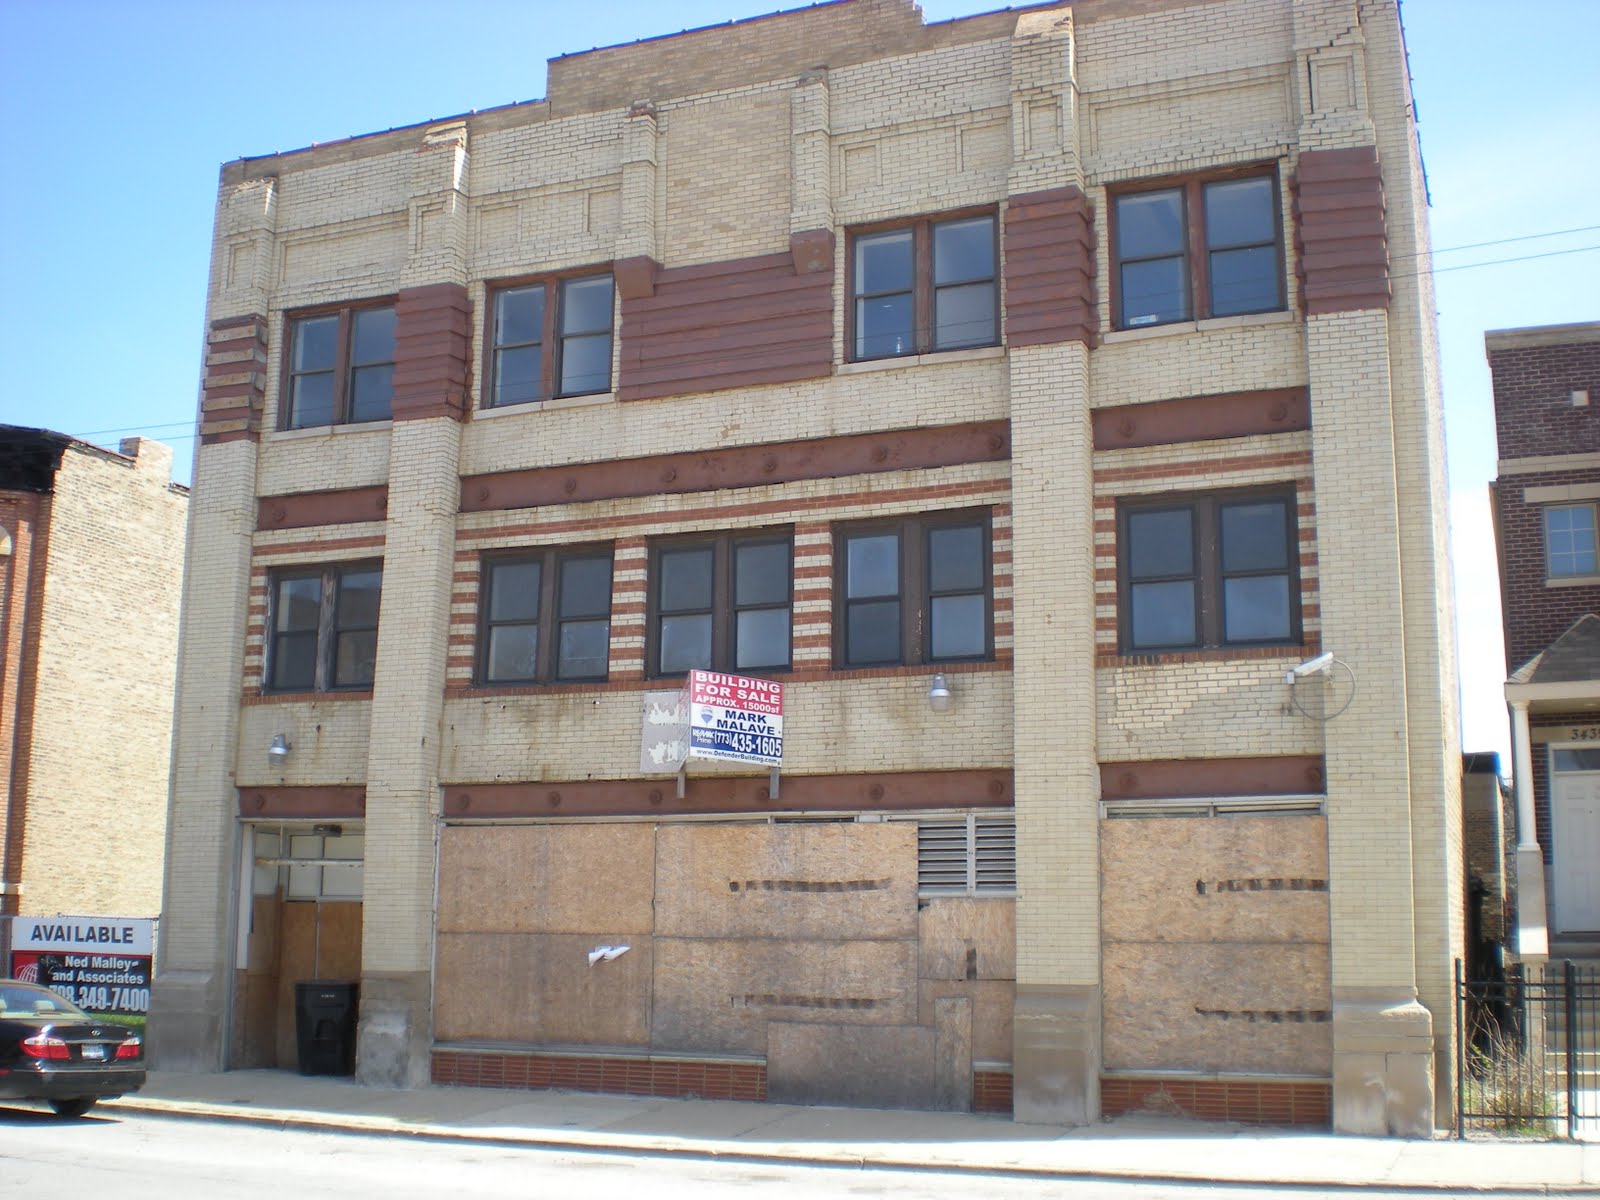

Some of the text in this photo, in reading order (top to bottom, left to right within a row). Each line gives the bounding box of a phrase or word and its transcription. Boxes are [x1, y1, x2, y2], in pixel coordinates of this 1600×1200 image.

[695, 672, 780, 693] BUILDING
[695, 684, 780, 704] FOR SALE
[696, 695, 780, 714] APPROX. 15000sf
[725, 710, 767, 724] MARK
[716, 720, 775, 736] MALAVE
[31, 925, 134, 944] AVAILABLE
[64, 955, 131, 972] Ned Malley
[52, 970, 144, 985] and Associates
